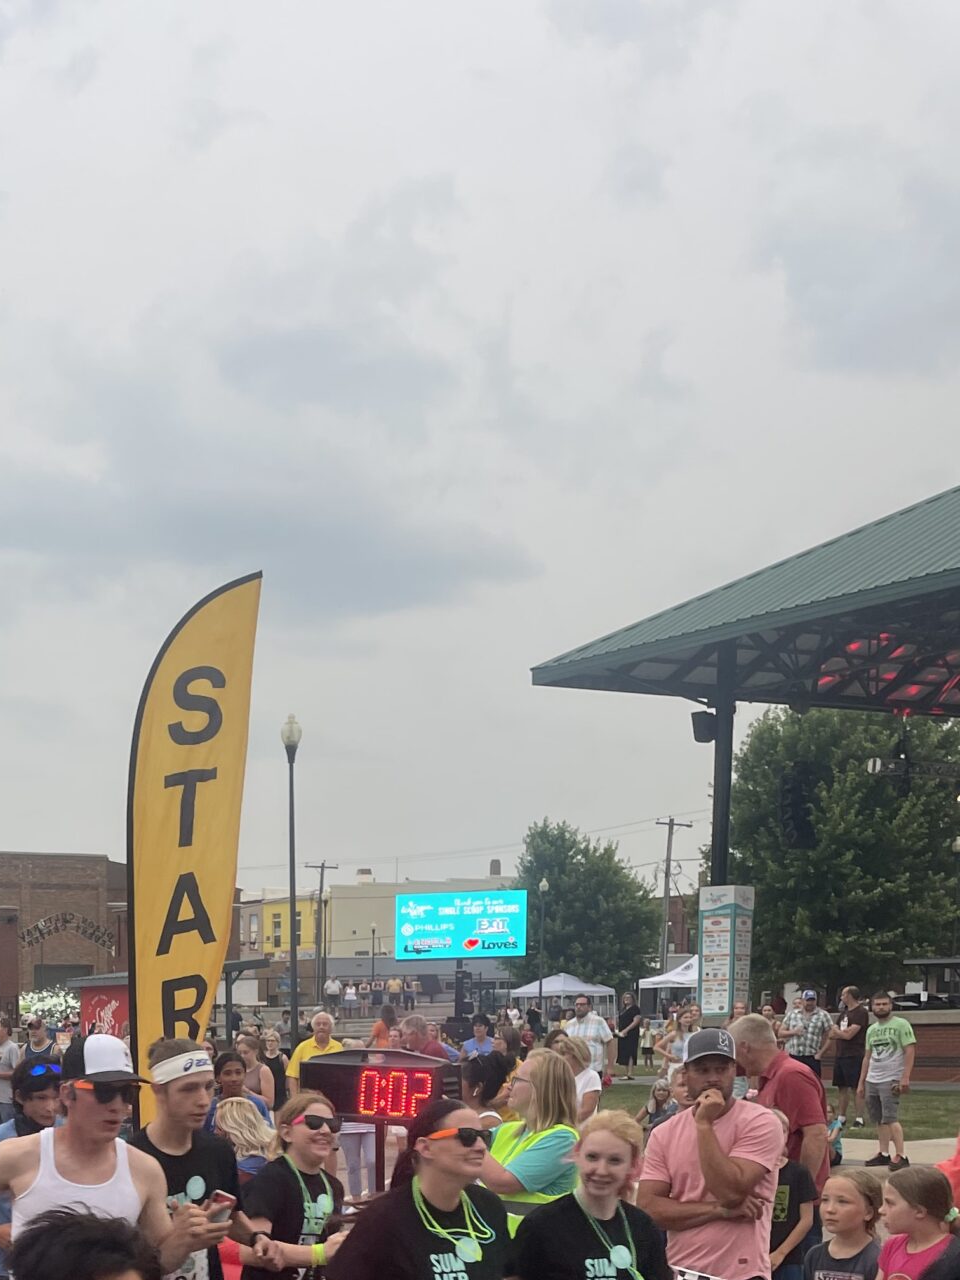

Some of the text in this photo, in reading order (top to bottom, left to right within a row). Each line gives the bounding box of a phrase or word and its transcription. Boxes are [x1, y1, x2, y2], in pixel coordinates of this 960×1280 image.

[414, 923, 455, 931] PHILLIPS
[430, 1252, 466, 1273] SUM
[585, 1258, 617, 1277] SUM
